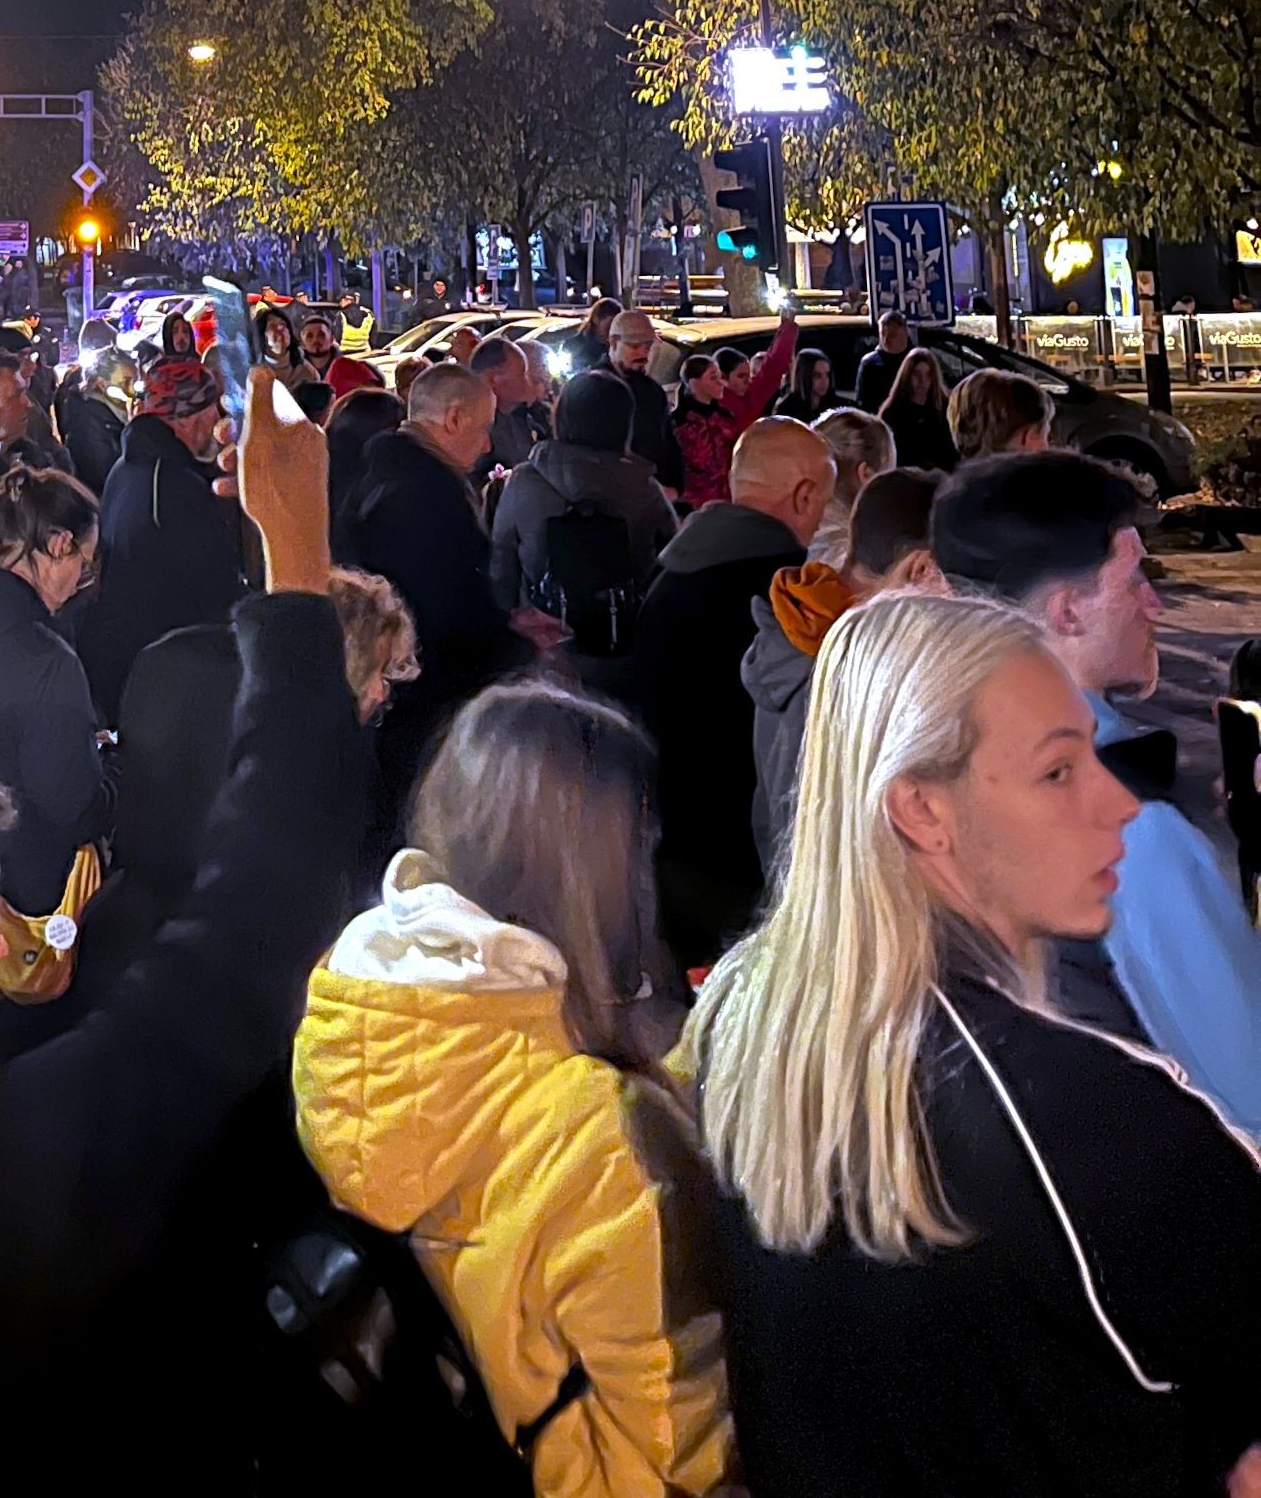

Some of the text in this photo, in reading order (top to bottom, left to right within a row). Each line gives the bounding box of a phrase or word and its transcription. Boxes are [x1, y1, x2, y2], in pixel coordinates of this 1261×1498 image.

[584, 207, 592, 238] P
[1036, 333, 1089, 347] viaGusto
[1209, 331, 1261, 345] viaGusto
